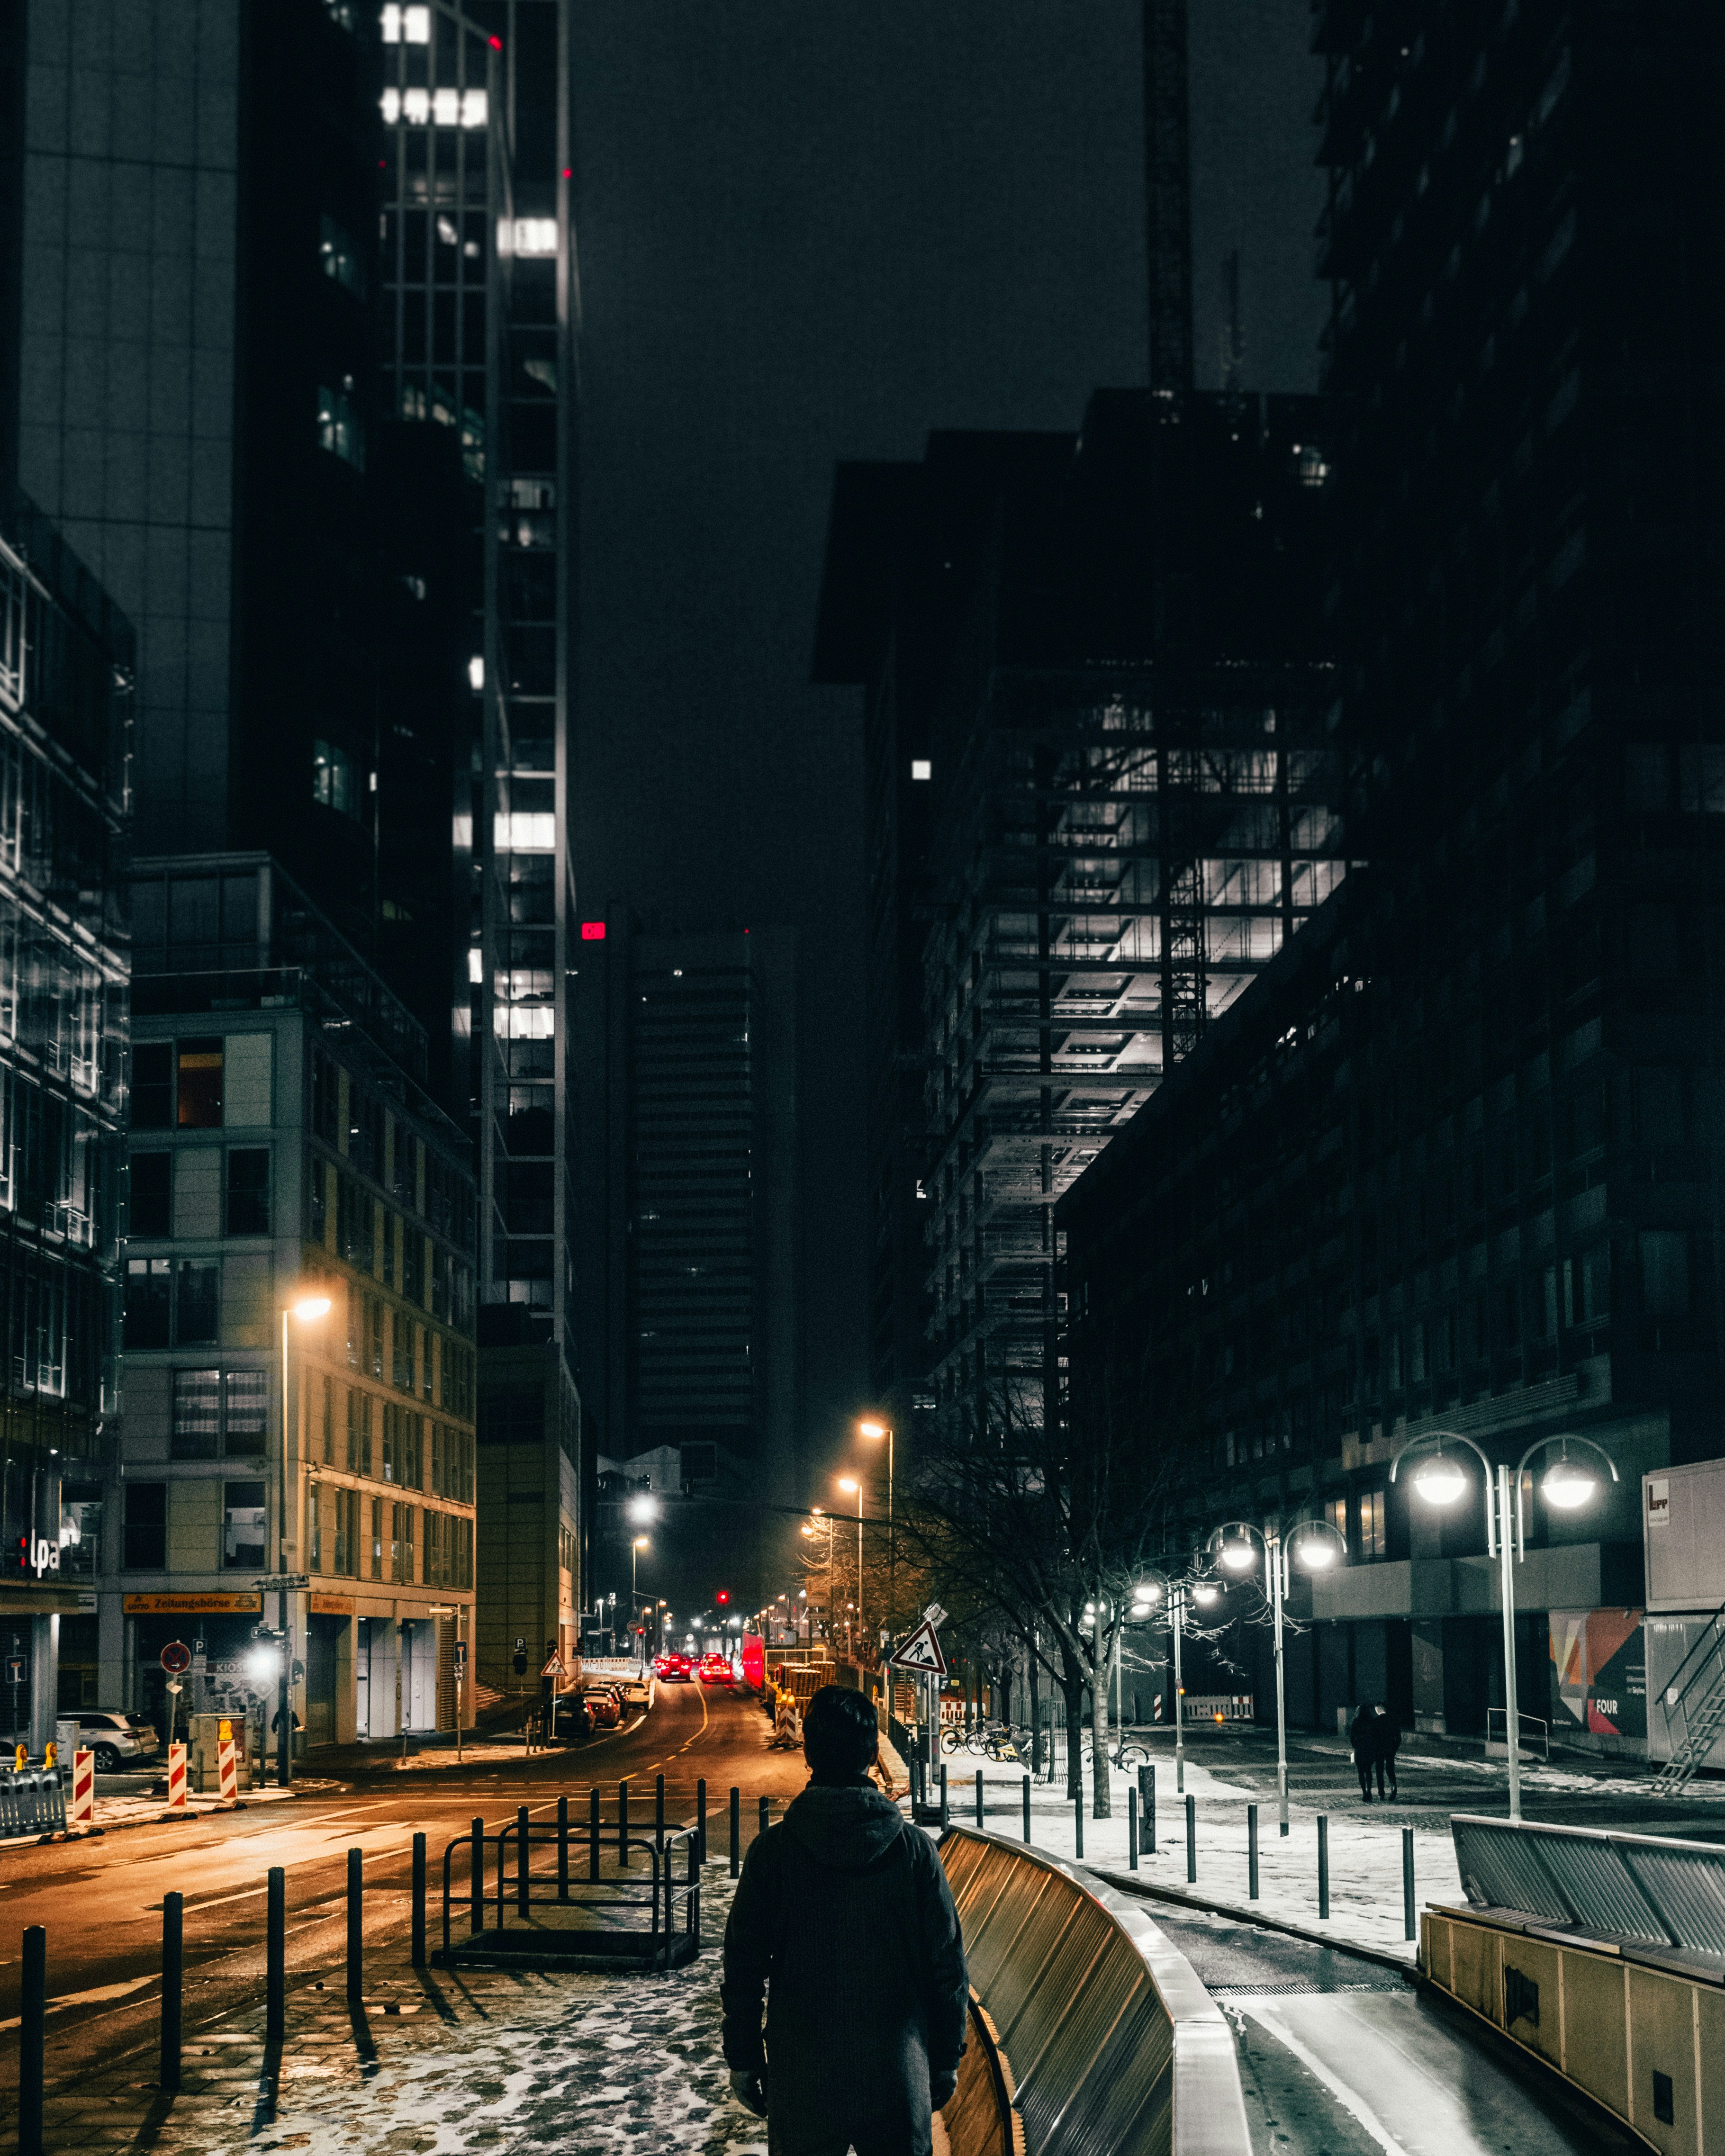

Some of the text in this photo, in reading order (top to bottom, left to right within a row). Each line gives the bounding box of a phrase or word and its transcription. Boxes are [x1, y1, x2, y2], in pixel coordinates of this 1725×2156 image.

[196, 1641, 204, 1652] P
[517, 1639, 524, 1648] P
[216, 1663, 249, 1672] KIOS
[1596, 1699, 1618, 1714] FOUR
